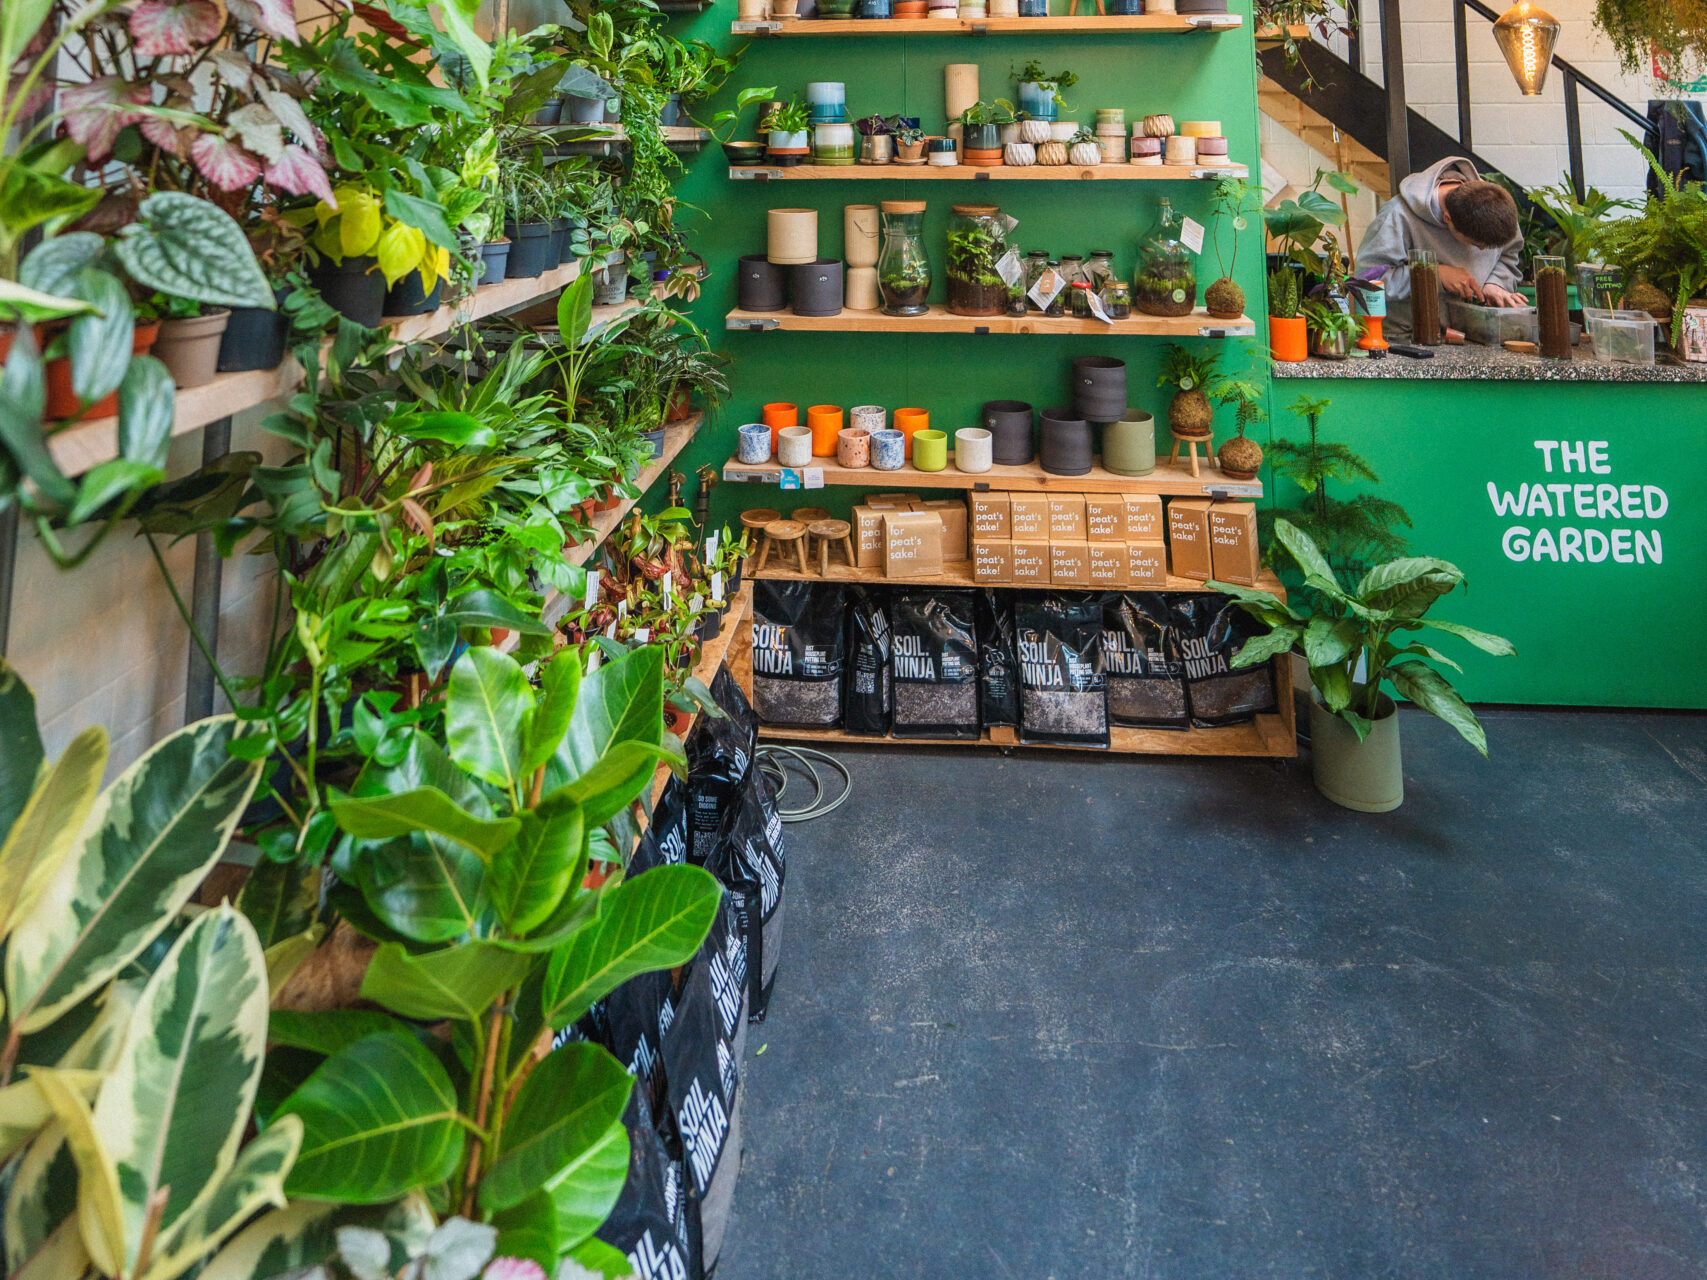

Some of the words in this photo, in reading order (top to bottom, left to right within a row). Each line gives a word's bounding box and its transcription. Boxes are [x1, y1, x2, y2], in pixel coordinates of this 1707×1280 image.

[1534, 440, 1611, 474] THE
[1486, 481, 1669, 519] WATERED
[976, 501, 988, 511] for
[1014, 502, 1026, 511] for
[1050, 501, 1064, 511] for
[1089, 504, 1102, 514] for
[1127, 502, 1140, 512] for
[976, 512, 1003, 522] peat's
[1014, 513, 1041, 523] peat's
[1051, 512, 1079, 523] peat's
[1128, 514, 1155, 524] peat's
[1171, 509, 1183, 519] for
[1212, 513, 1225, 523] for
[861, 516, 874, 526] for
[1090, 515, 1117, 525] peat's
[890, 524, 904, 536] for
[976, 522, 999, 531] sake!
[1015, 523, 1037, 532] sake!
[1052, 522, 1075, 531] sake!
[1090, 525, 1114, 534] sake!
[1128, 523, 1151, 532] sake!
[1172, 521, 1199, 531] peat's
[1213, 525, 1242, 535] peat's
[1172, 531, 1196, 542] sake!
[1214, 535, 1238, 545] sake!
[890, 536, 922, 549] peat's
[1502, 526, 1663, 564] GARDEN
[890, 549, 917, 560] sake!
[976, 545, 989, 555] for
[1014, 545, 1027, 555] for
[1053, 547, 1066, 556] for
[1091, 547, 1104, 557] for
[1129, 546, 1143, 556] for
[976, 556, 1004, 566] peat's
[1015, 556, 1042, 567] peat's
[1054, 558, 1081, 568] peat's
[1092, 559, 1120, 569] peat's
[1130, 558, 1158, 568] peat's
[977, 566, 1000, 575] sake!
[1015, 567, 1038, 576] sake!
[1054, 568, 1077, 577] sake!
[1092, 569, 1115, 578] sake!
[1130, 568, 1154, 577] sake!
[894, 635, 930, 656] SOIL.
[1181, 636, 1219, 660] SOIL.
[1020, 641, 1056, 664] SOIL.
[894, 656, 936, 679] NINJA
[1185, 654, 1228, 679] NINJA
[1021, 662, 1064, 686] NINJA
[691, 1094, 728, 1193] NINJA
